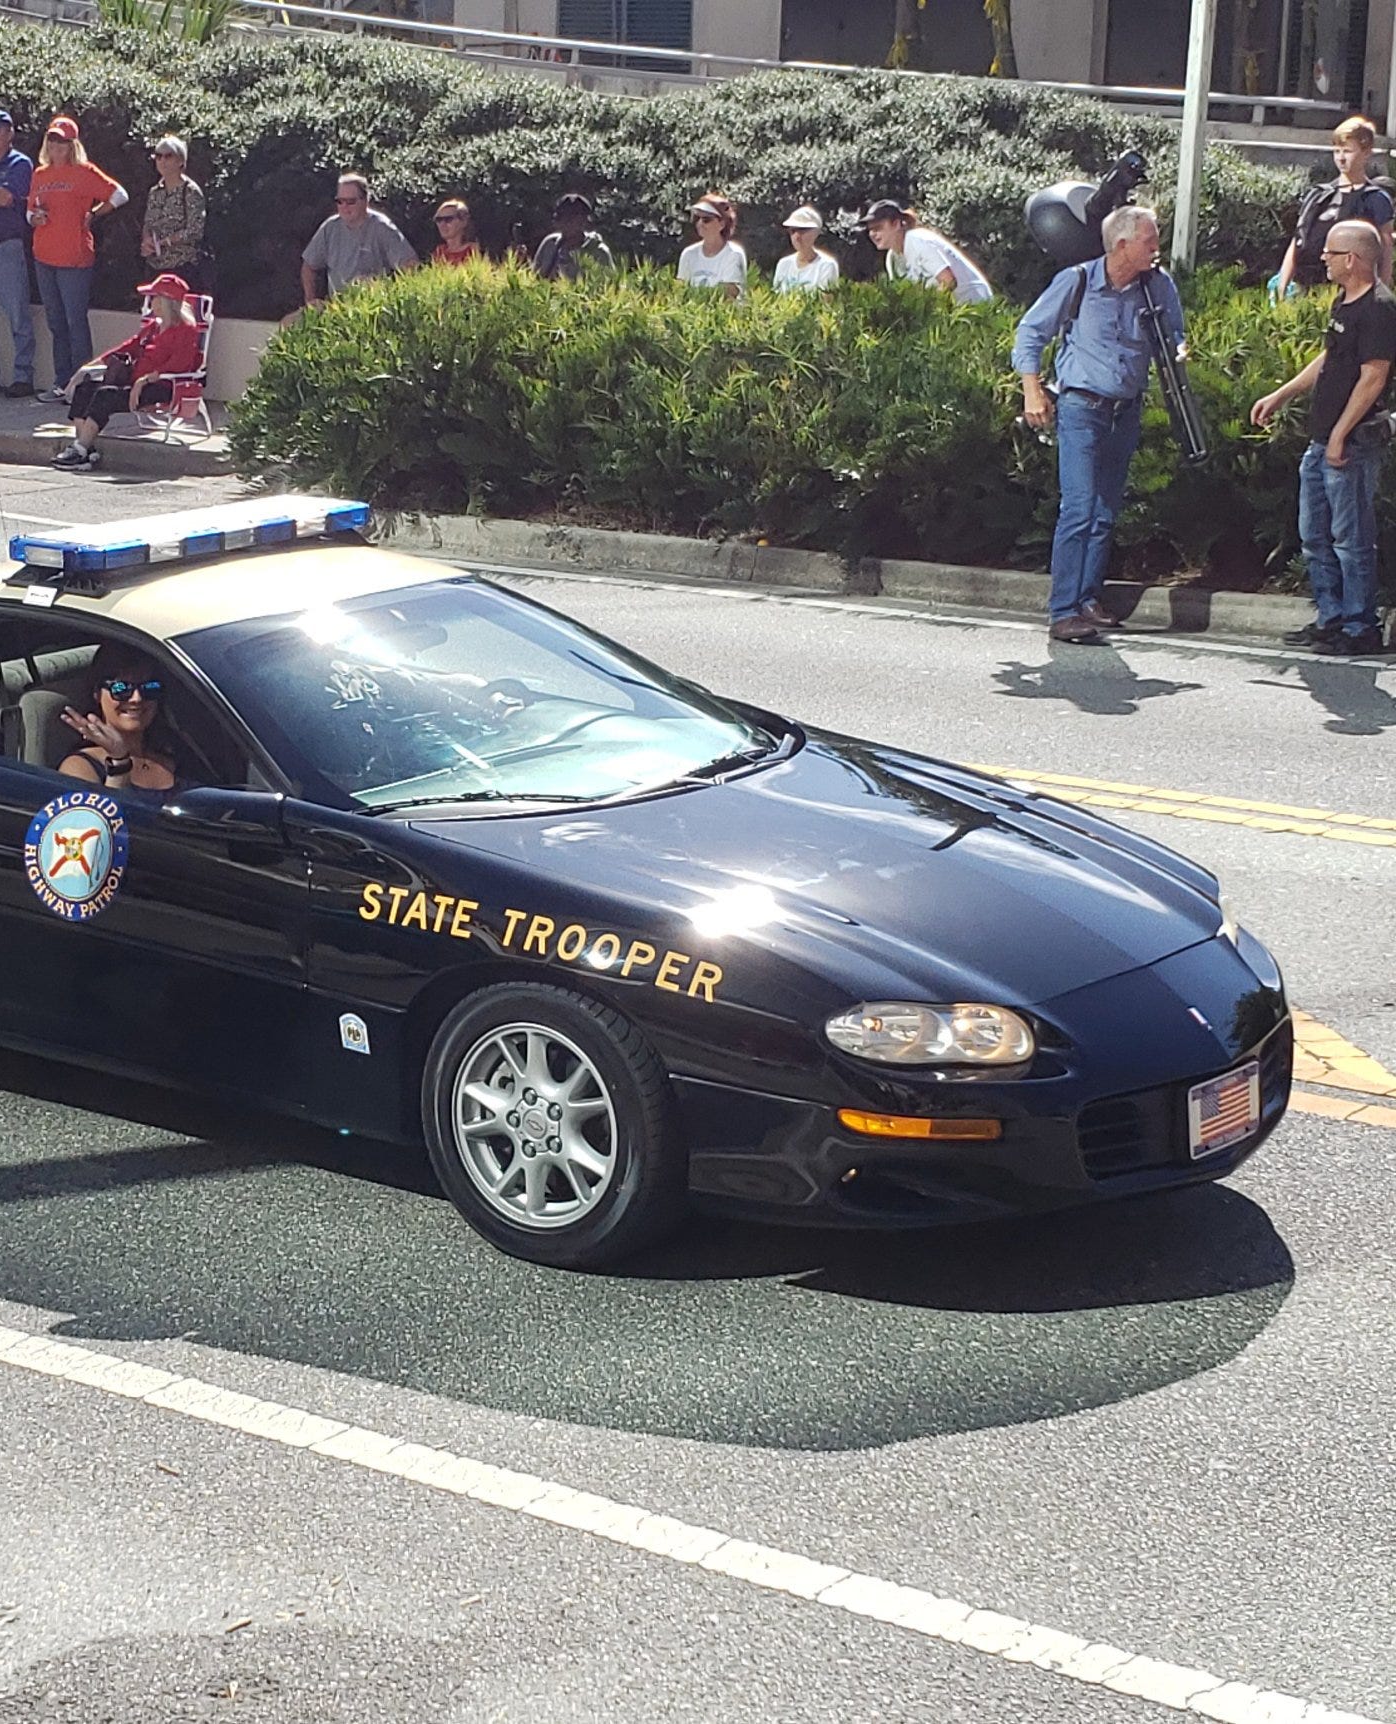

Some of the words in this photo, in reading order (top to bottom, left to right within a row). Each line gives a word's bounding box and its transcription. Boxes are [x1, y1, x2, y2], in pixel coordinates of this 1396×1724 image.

[43, 792, 124, 834] FLORIDA
[25, 843, 75, 918] HIGHWAY
[79, 866, 124, 918] PATROL
[358, 883, 479, 939] STATE
[502, 908, 724, 1003] TROOPER
